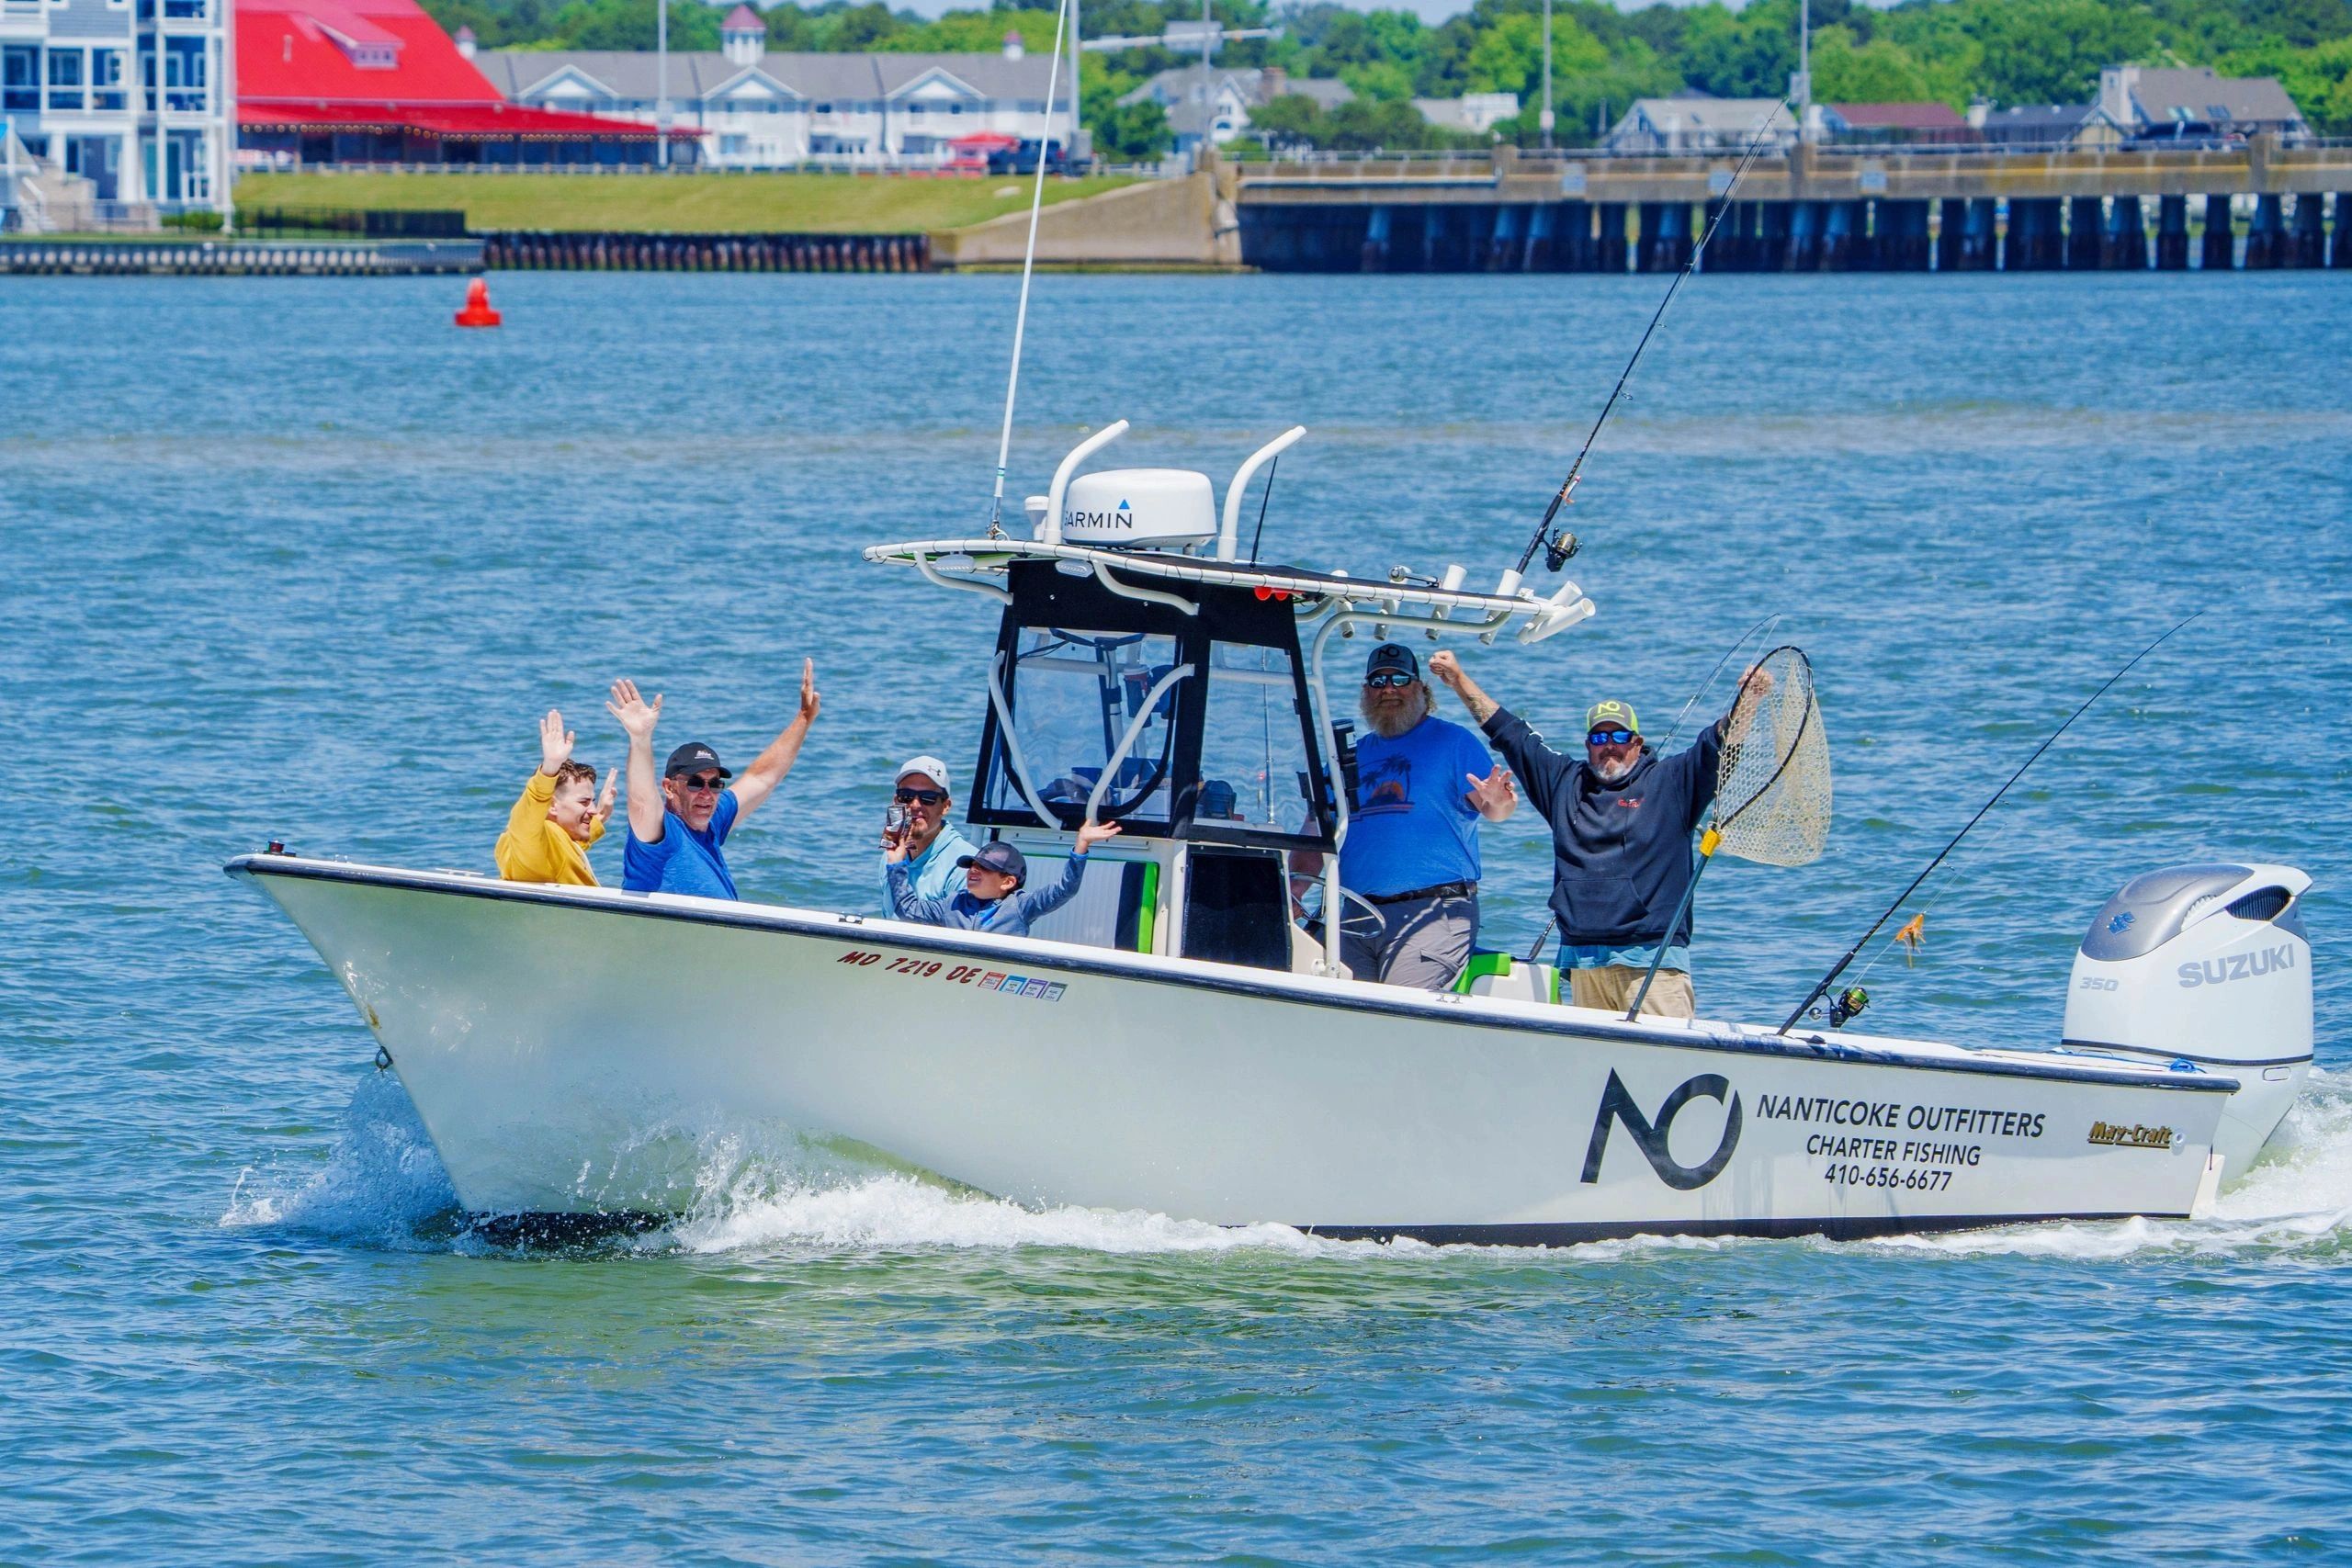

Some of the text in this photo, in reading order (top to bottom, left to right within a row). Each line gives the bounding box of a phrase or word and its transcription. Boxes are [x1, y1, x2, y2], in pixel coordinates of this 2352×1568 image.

[1598, 701, 1620, 714] NO
[836, 951, 882, 965] MD
[885, 957, 943, 977] 7219
[945, 965, 982, 984] DE
[2177, 942, 2295, 988] SUZUKI
[2079, 976, 2120, 992] 350
[1580, 1066, 1743, 1190] NO
[1757, 1094, 2046, 1138] NANTICOKE OUTFITTERS
[2088, 1121, 2172, 1145] May-Craft
[1806, 1134, 1982, 1166] CHARTER FISHING
[1825, 1164, 1952, 1191] 410-656-6677
